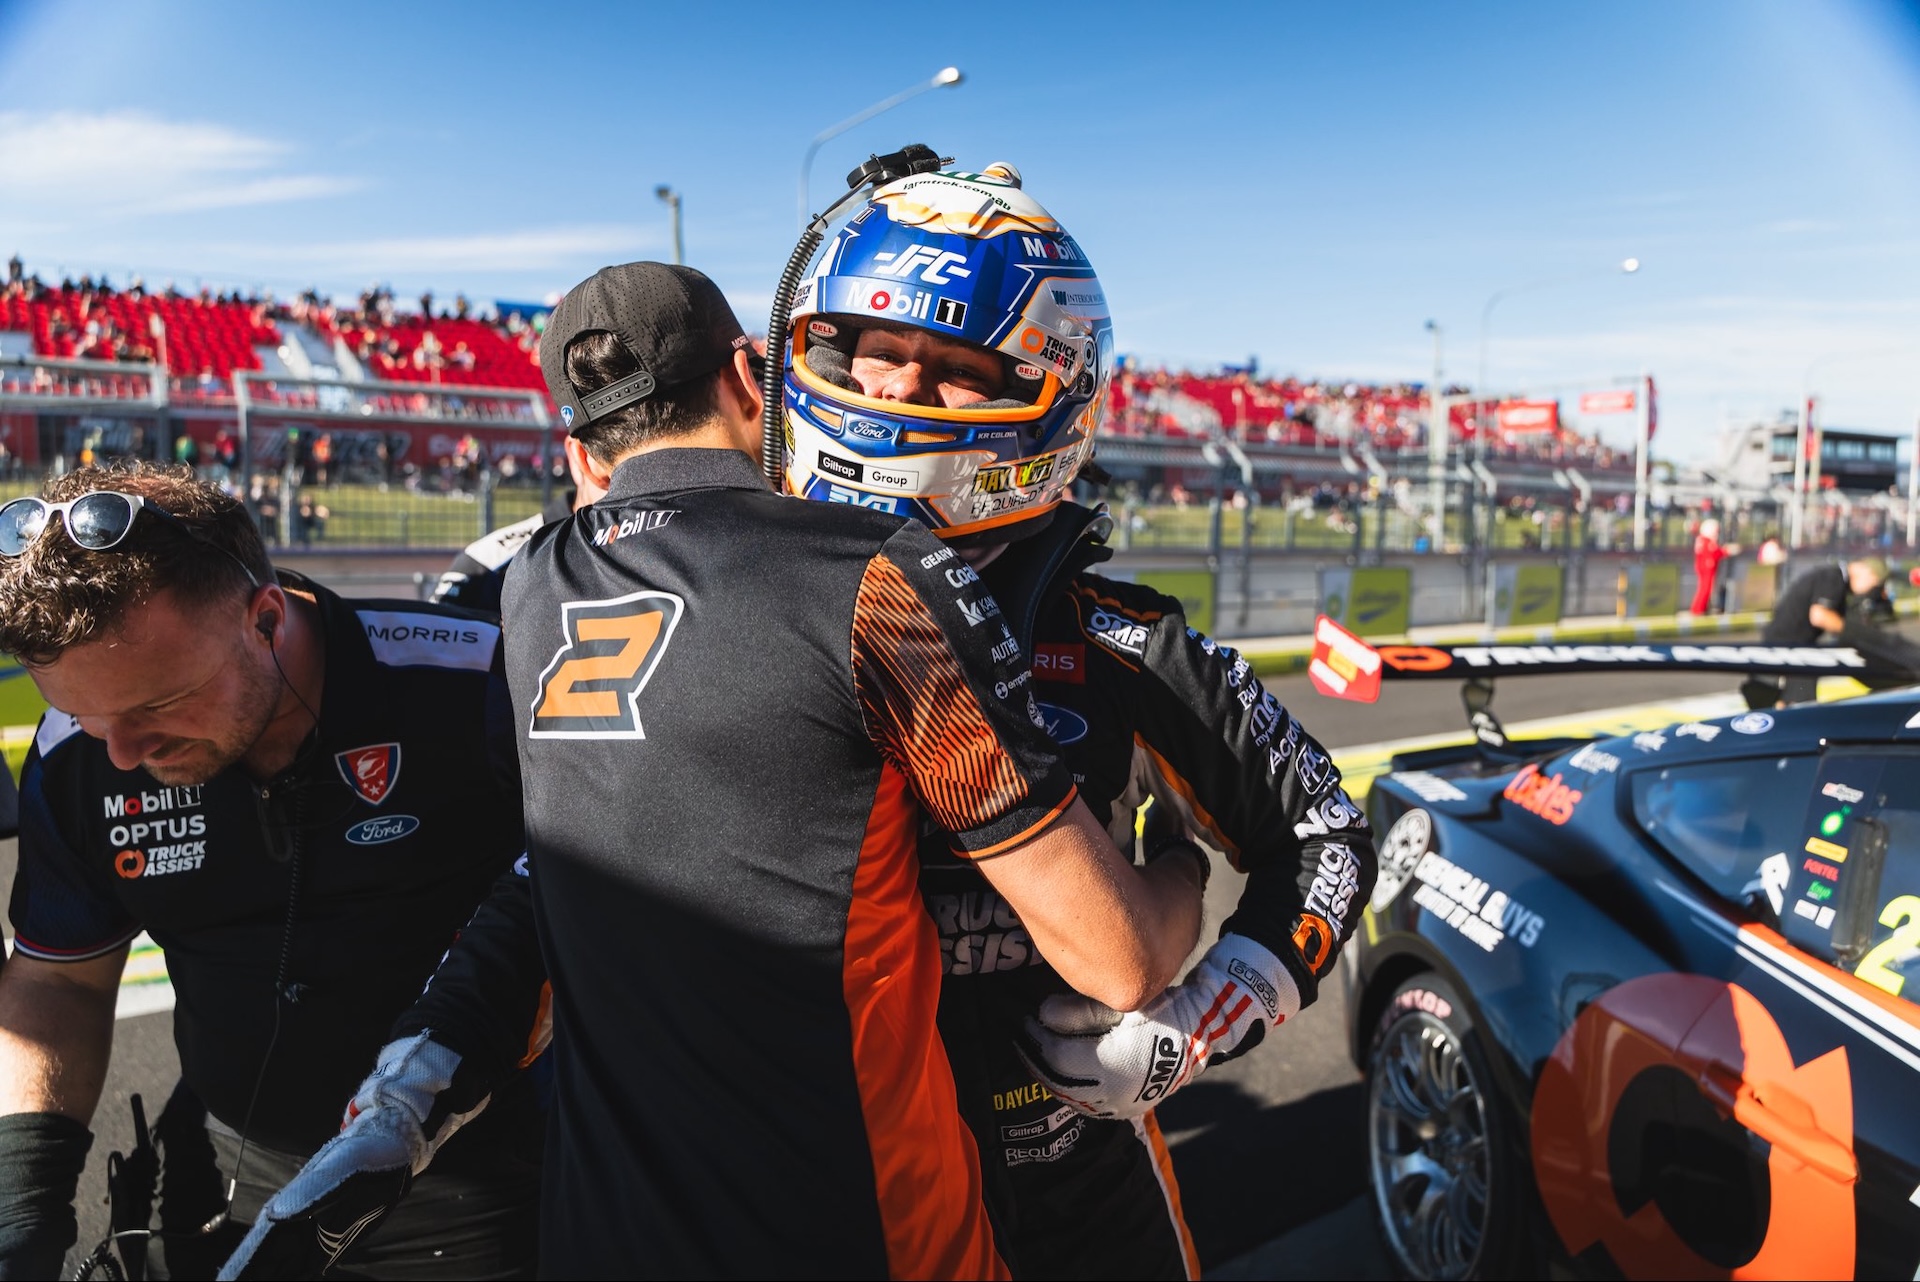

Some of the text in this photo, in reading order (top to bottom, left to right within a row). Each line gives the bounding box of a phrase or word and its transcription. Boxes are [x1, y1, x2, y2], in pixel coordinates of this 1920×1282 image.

[1022, 236, 1078, 260] Mobil
[845, 281, 932, 319] Mobil
[812, 323, 833, 334] BELL
[1040, 347, 1074, 371] ASSIST
[1045, 335, 1079, 360] TRUCK
[1018, 366, 1039, 376] BELL
[854, 421, 886, 439] Ford
[822, 456, 907, 487] Giltrap Group
[591, 510, 646, 547] Mobil
[368, 624, 479, 643] MORRIS
[1091, 612, 1147, 647] OMP
[533, 602, 673, 727] 2
[104, 788, 174, 819] Mobil
[110, 814, 207, 847] OPTUS
[361, 818, 405, 841] Ford
[143, 855, 206, 878] ASSIST
[148, 840, 207, 862] TRUCK
[1304, 842, 1349, 918] TRUCK
[1480, 891, 1546, 948] GUYS
[1854, 894, 1920, 997] 2
[1233, 961, 1278, 1014] raceline
[1142, 1036, 1179, 1101] OMP
[1008, 1124, 1045, 1137] Giltrap
